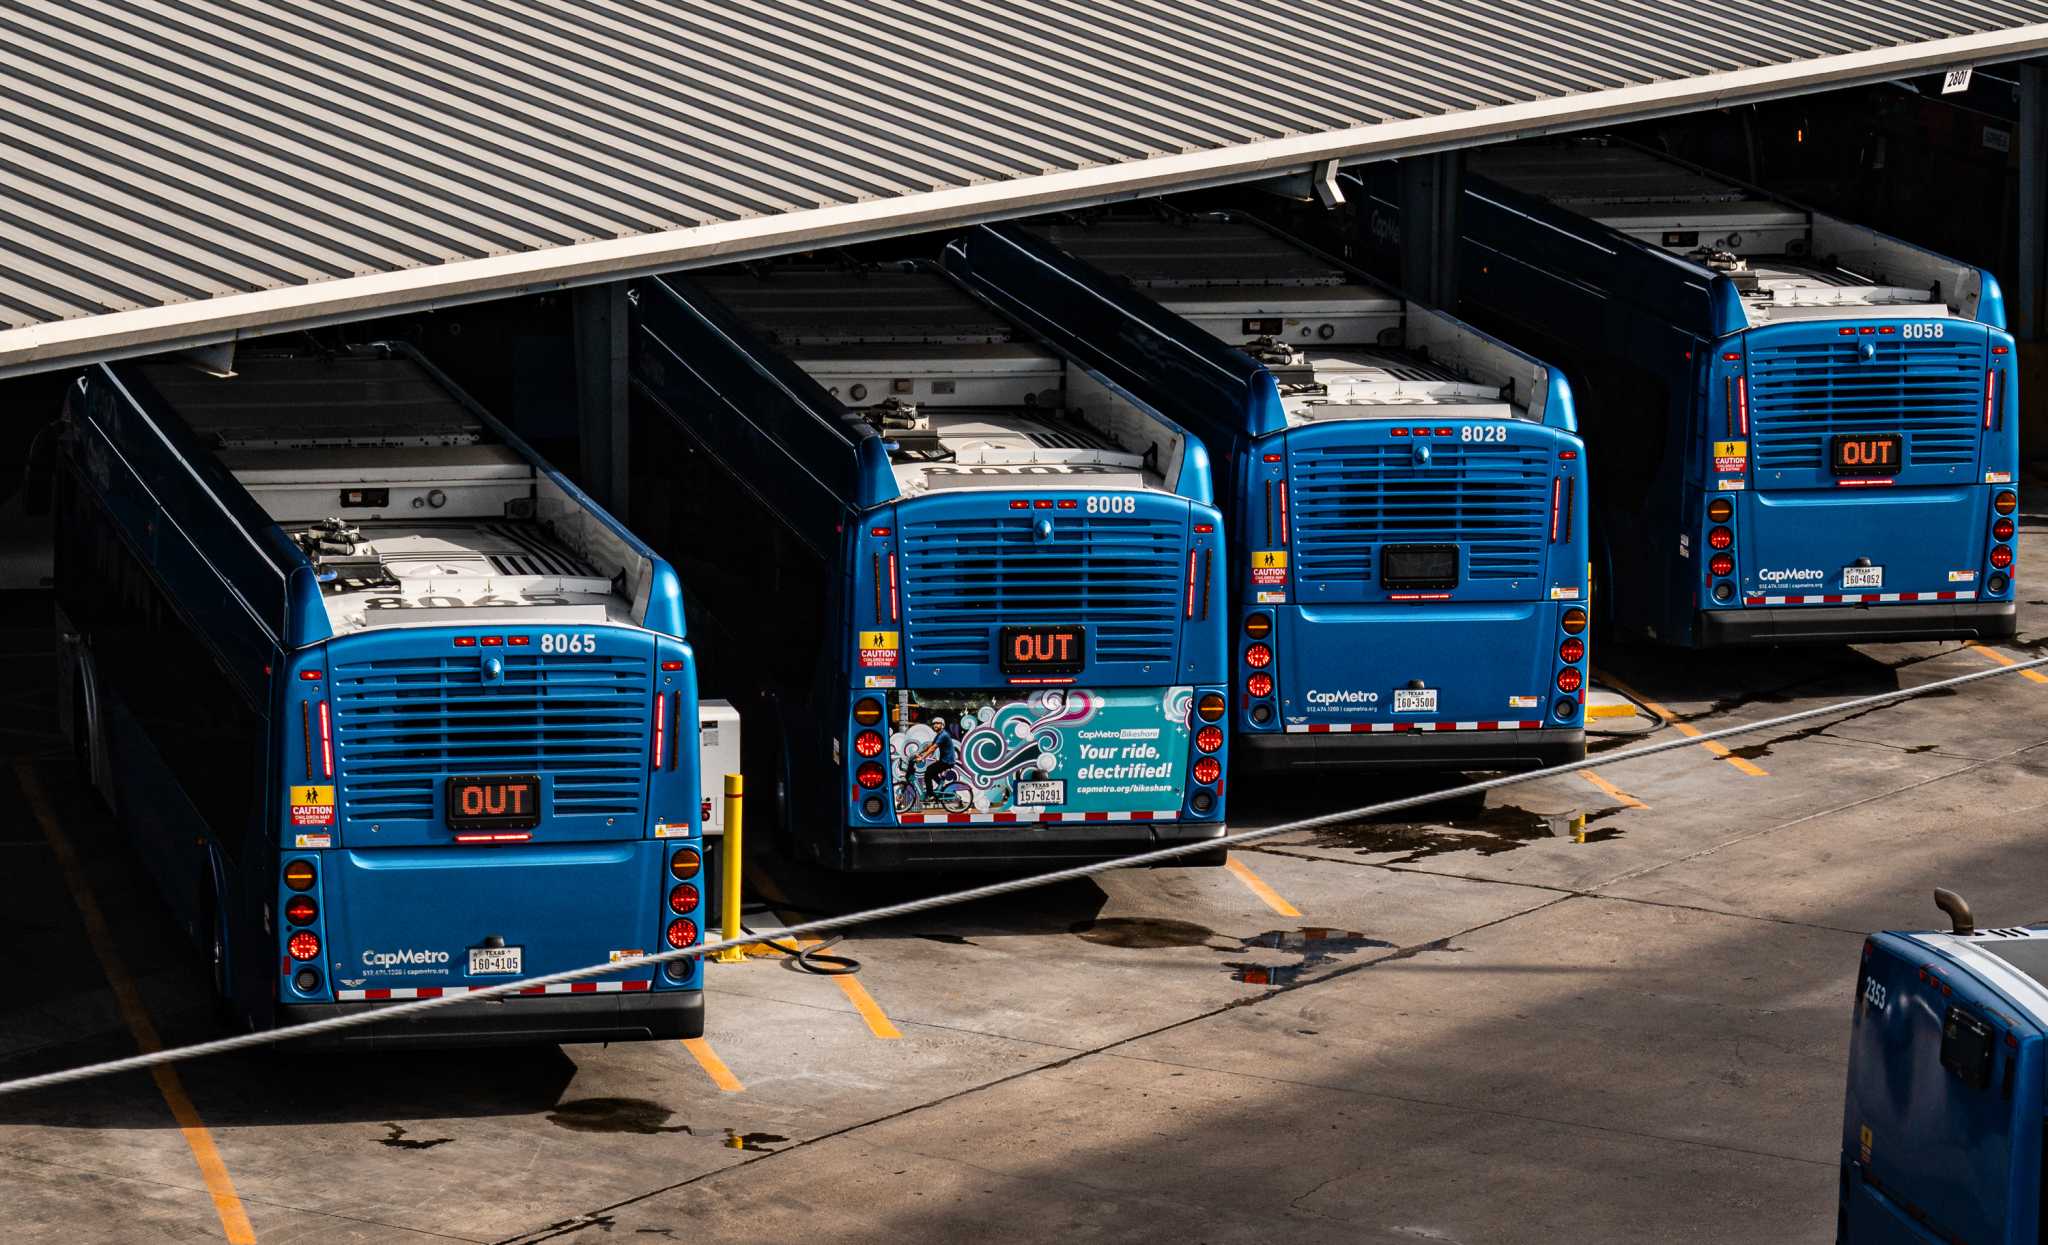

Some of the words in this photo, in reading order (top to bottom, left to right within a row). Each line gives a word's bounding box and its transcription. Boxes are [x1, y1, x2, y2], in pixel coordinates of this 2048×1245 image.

[1903, 323, 1944, 338] 8058
[1461, 425, 1506, 441] 8028
[1843, 441, 1892, 464] OUT
[1086, 496, 1135, 513] 8008
[1253, 568, 1286, 576] CAUTION
[1759, 568, 1823, 583] CapMetro
[541, 634, 596, 653] 8065
[1015, 634, 1073, 661] OUT
[1307, 689, 1378, 706] CapMetro
[1078, 730, 1120, 740] CapMetro
[1080, 744, 1118, 759] Your
[1122, 743, 1160, 759] ride,
[1077, 762, 1173, 779] electrified!
[1077, 784, 1172, 794] capmetro.org/bikeshare
[462, 785, 527, 815] OUT
[292, 806, 332, 815] CAUTION
[362, 949, 449, 968] CapMetro
[1865, 976, 1886, 1009] 2353
